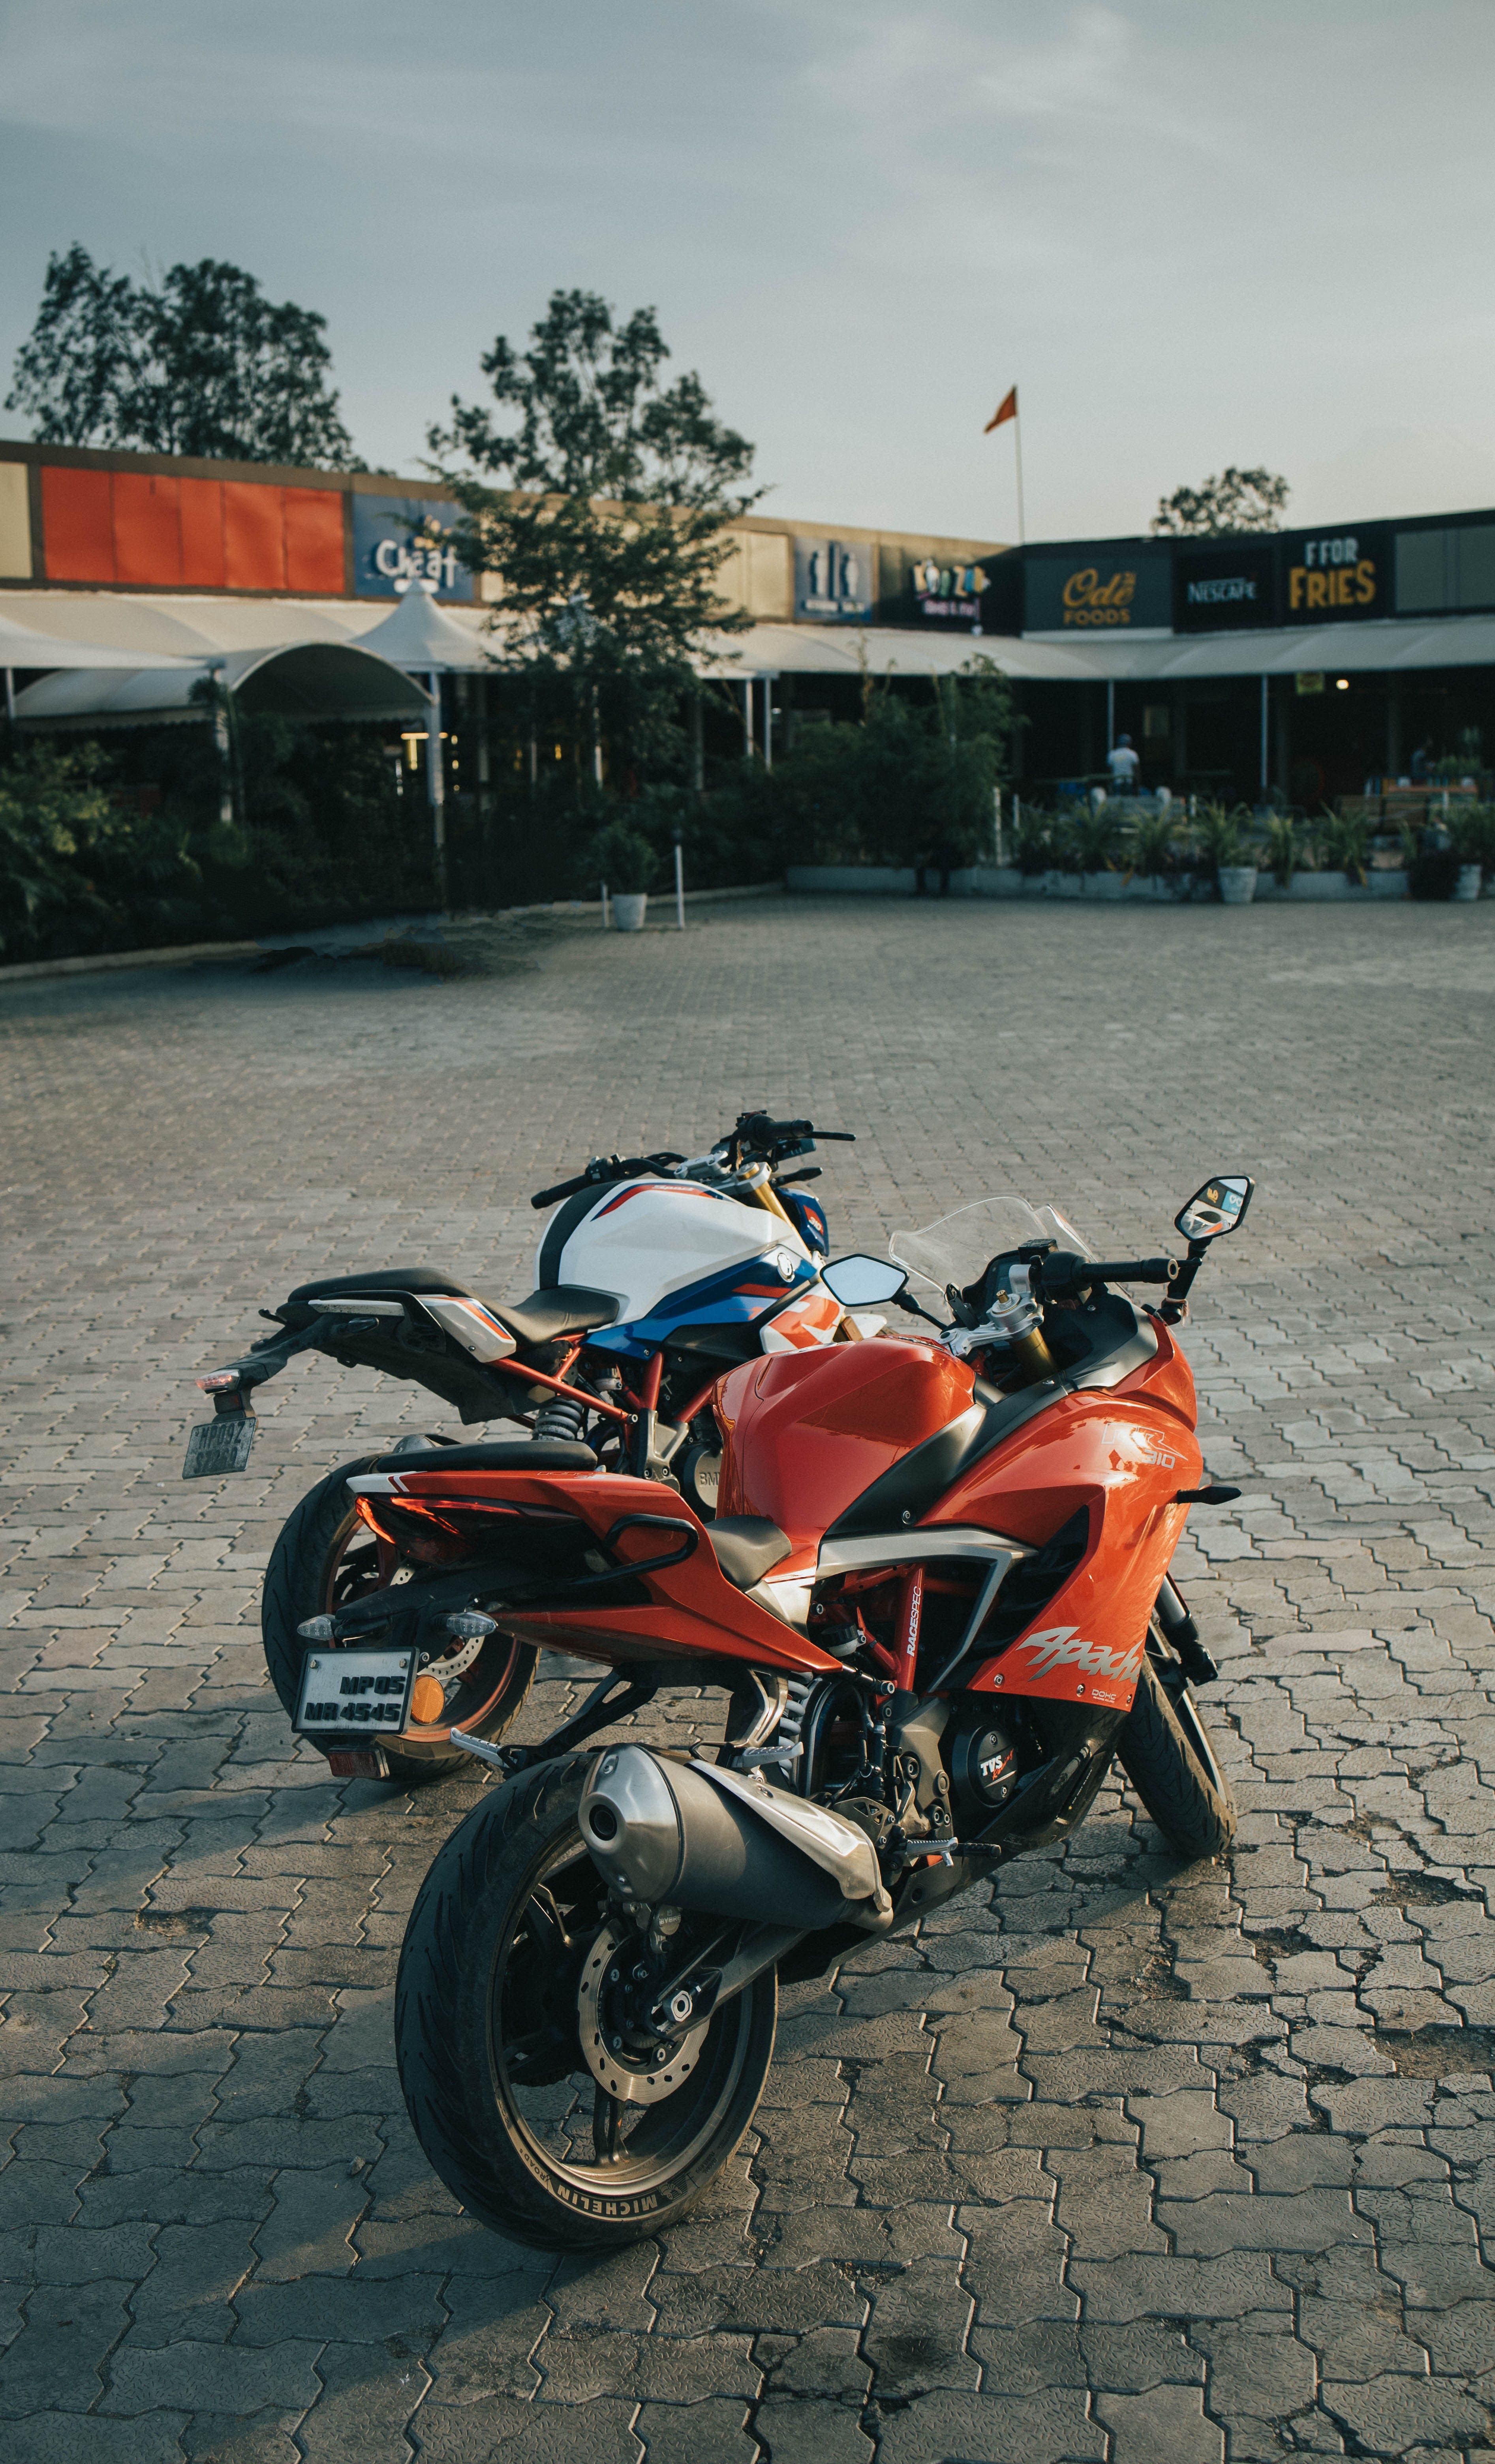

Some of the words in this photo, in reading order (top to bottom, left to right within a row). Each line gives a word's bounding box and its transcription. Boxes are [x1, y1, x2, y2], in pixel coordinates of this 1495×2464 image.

[1289, 559, 1376, 609] FRIES
[1064, 608, 1130, 625] FOODS
[808, 1216, 822, 1231] 310
[1142, 1448, 1176, 1469] 310
[699, 1472, 721, 1486] BM
[907, 1586, 921, 1657] RACESPEC
[339, 1675, 406, 1695] MP05
[1091, 1688, 1117, 1700] DOHC
[304, 1702, 338, 1721] MR
[340, 1702, 402, 1722] 4545
[980, 1754, 1003, 1776] TVS
[524, 2153, 547, 2181] ROAD
[557, 2184, 658, 2215] MICHELIN
